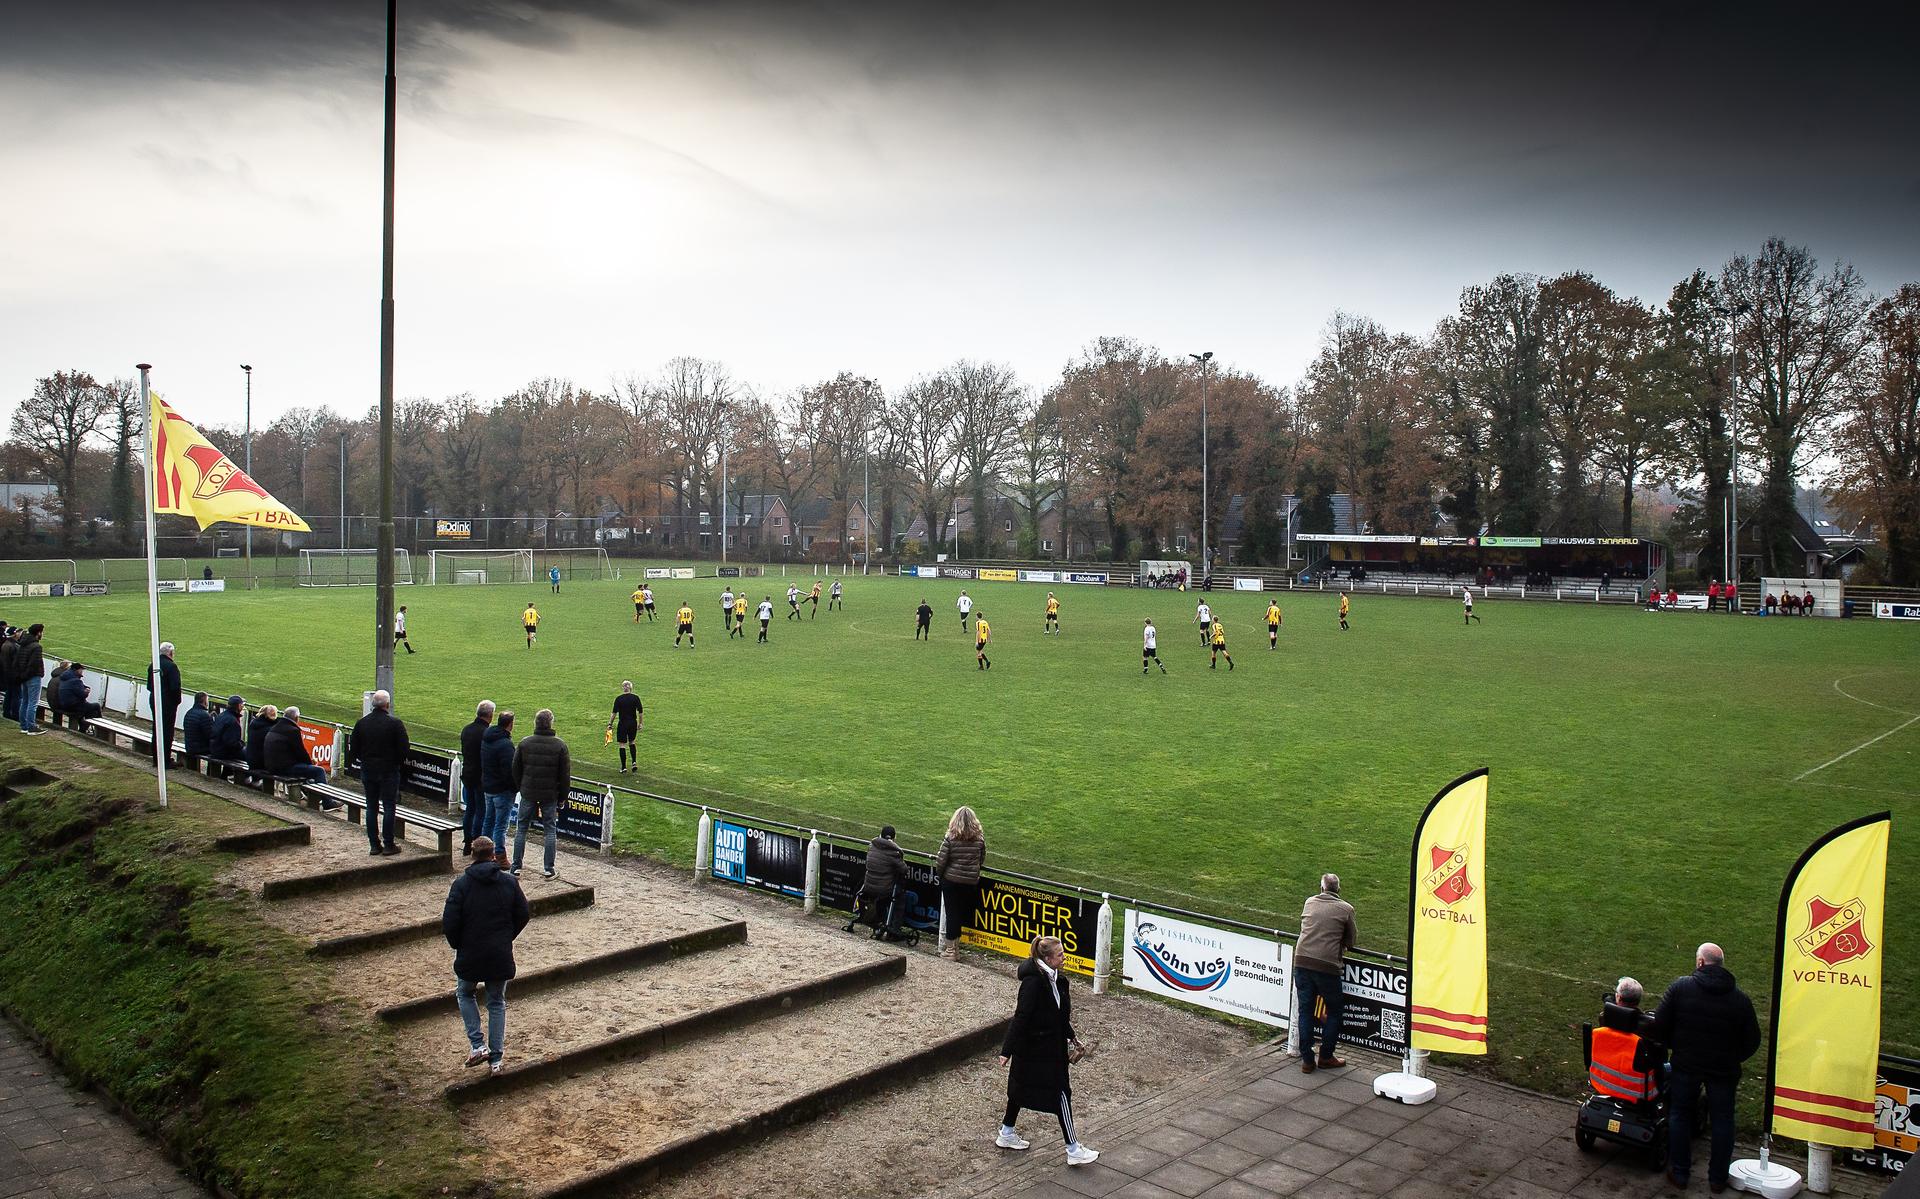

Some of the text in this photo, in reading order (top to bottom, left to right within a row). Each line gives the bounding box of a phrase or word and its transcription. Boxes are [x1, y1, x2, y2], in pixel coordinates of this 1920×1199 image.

[1075, 574, 1100, 582] Rabobank
[312, 743, 334, 763] COO
[715, 828, 744, 851] AUTO
[715, 846, 744, 864] BANDEN
[981, 888, 1072, 929] WOLTER
[1421, 907, 1477, 924] VOETBAL
[974, 909, 1078, 952] NIENHUIS
[1804, 908, 1860, 946] V.A.K.O.
[1160, 928, 1224, 950] VISHANDEL
[1153, 942, 1225, 975] John Vos
[1234, 956, 1283, 975] Een zee van
[1234, 968, 1284, 987] gezondheid!
[1792, 969, 1872, 988] VOETBAL
[1369, 991, 1386, 999] SIGN
[1354, 1014, 1380, 1022] wedstrijd
[1882, 1153, 1908, 1172] ke
